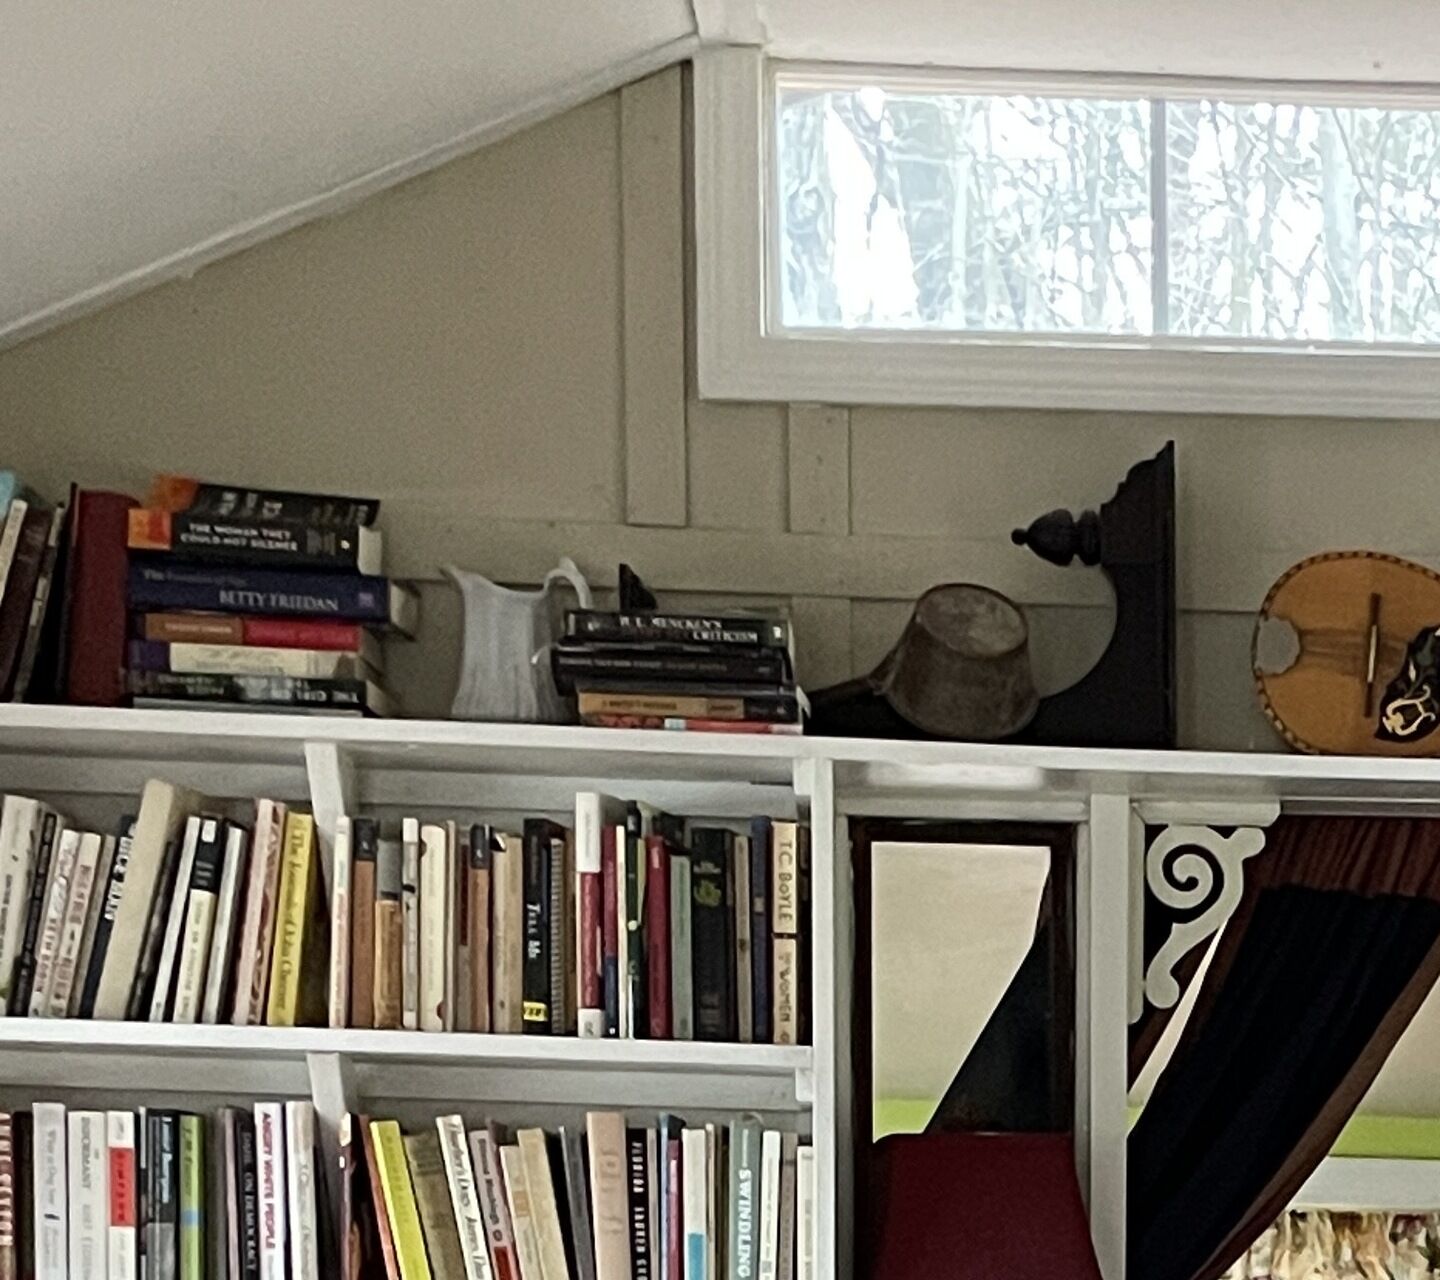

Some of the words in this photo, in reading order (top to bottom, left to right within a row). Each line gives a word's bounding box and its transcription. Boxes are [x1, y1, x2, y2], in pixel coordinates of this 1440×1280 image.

[219, 588, 264, 607] BETTY
[269, 594, 339, 613] FRIEDAN
[290, 833, 304, 855] The
[777, 870, 793, 922] BOYLE
[527, 901, 543, 935] TELL
[778, 969, 792, 1023] WOMEN
[262, 1112, 273, 1155] ANGRY
[243, 1172, 253, 1191] ON
[263, 1159, 274, 1198] WHITE
[264, 1202, 275, 1249] PEOPLE
[737, 1168, 753, 1278] SWINDLING
